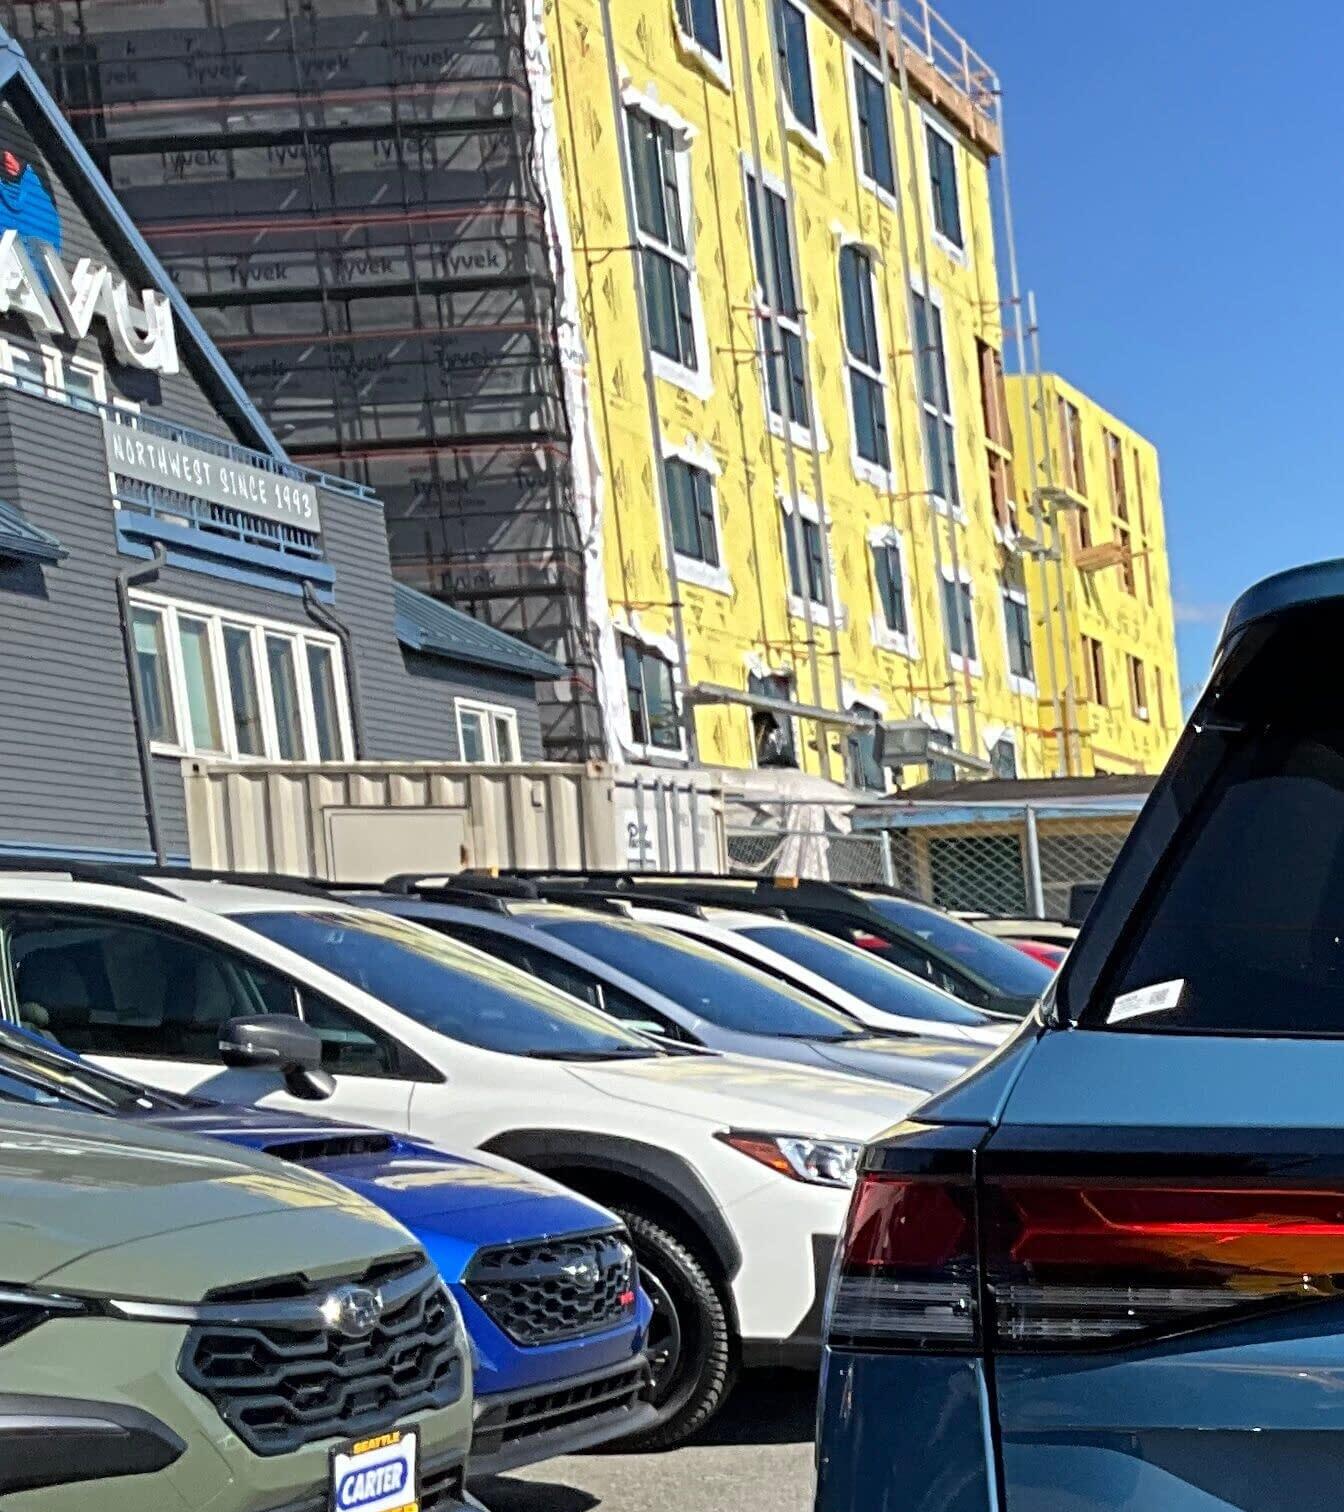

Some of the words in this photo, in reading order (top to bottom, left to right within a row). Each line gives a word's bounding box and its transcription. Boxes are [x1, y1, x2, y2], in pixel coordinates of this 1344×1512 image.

[112, 434, 212, 486] NORTHWEST
[219, 467, 267, 504] SINCE
[274, 484, 312, 518] 1993
[353, 1431, 400, 1455] SEATTLE
[342, 1461, 403, 1506] CARTER
